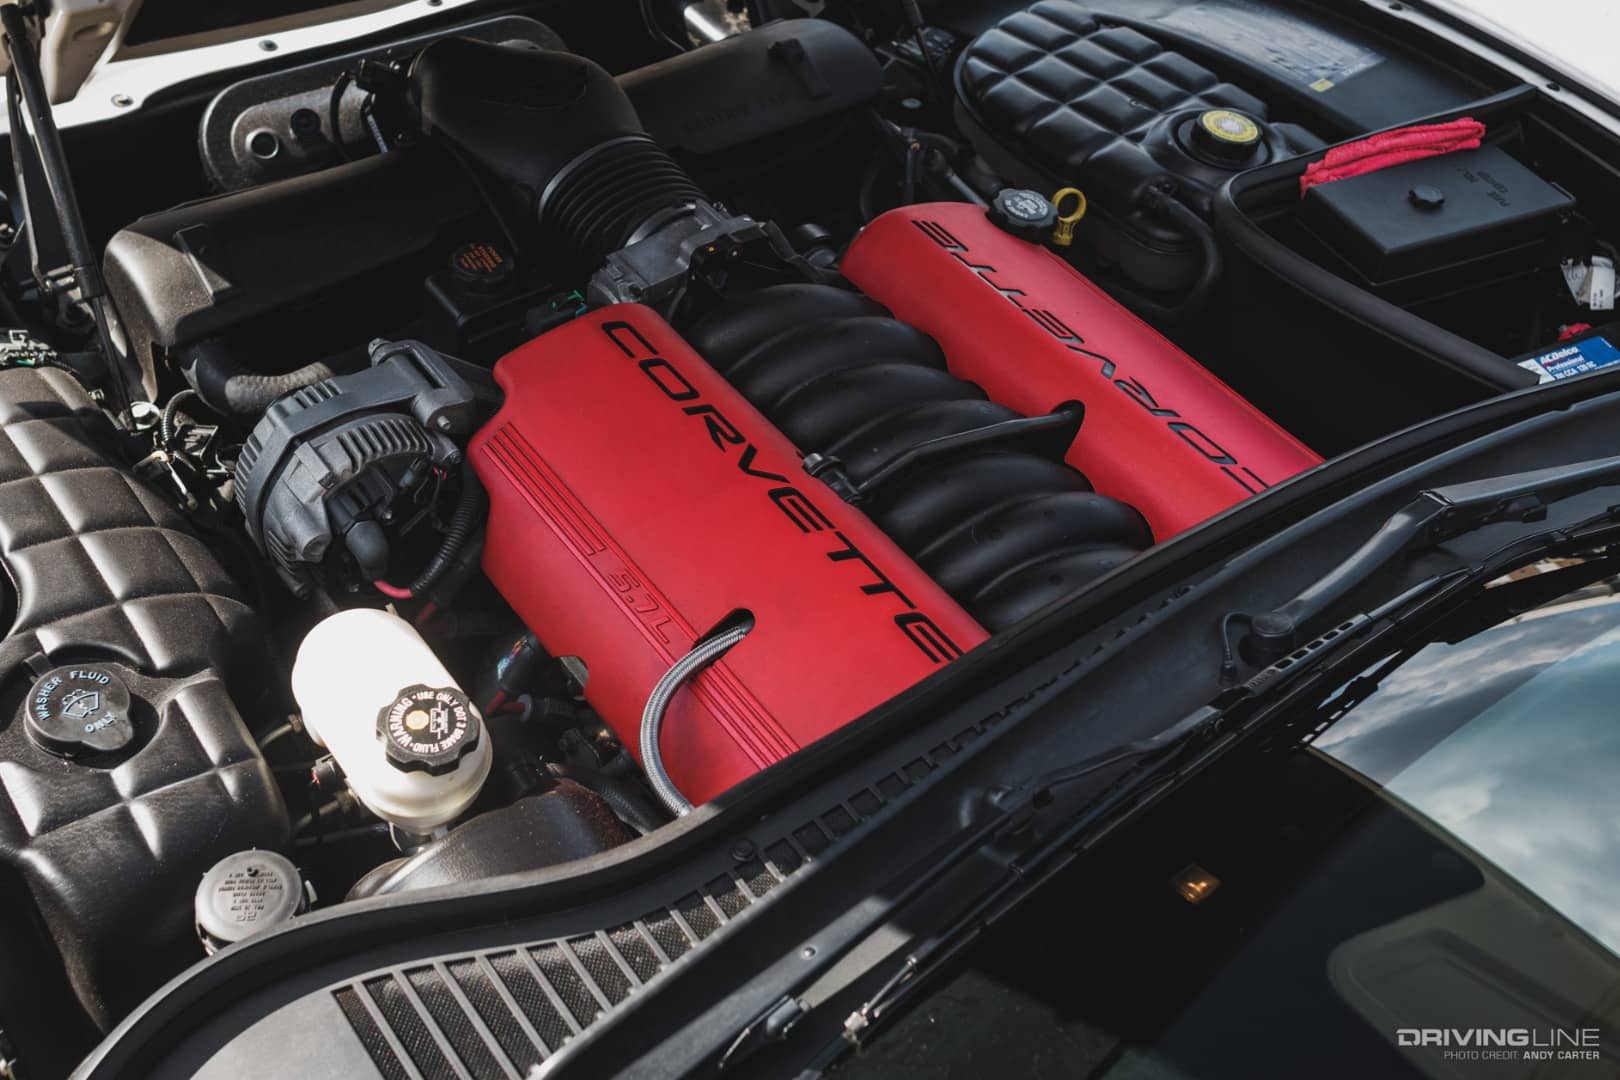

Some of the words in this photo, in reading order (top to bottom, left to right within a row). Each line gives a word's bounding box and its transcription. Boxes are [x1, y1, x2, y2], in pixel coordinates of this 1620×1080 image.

[911, 220, 1269, 494] CORVETTE
[1540, 347, 1578, 364] ACDelco
[601, 321, 963, 662] CORVETTE
[607, 568, 671, 644] 5.7L
[36, 676, 63, 720] WASHER
[70, 670, 110, 685] FLUID
[416, 691, 435, 701] USE
[436, 692, 459, 707] ONLY
[85, 711, 117, 733] ONLY
[390, 697, 414, 747] WARNING
[453, 706, 467, 721] DOT
[412, 742, 440, 753] FLUID
[440, 728, 465, 750] BRAKE
